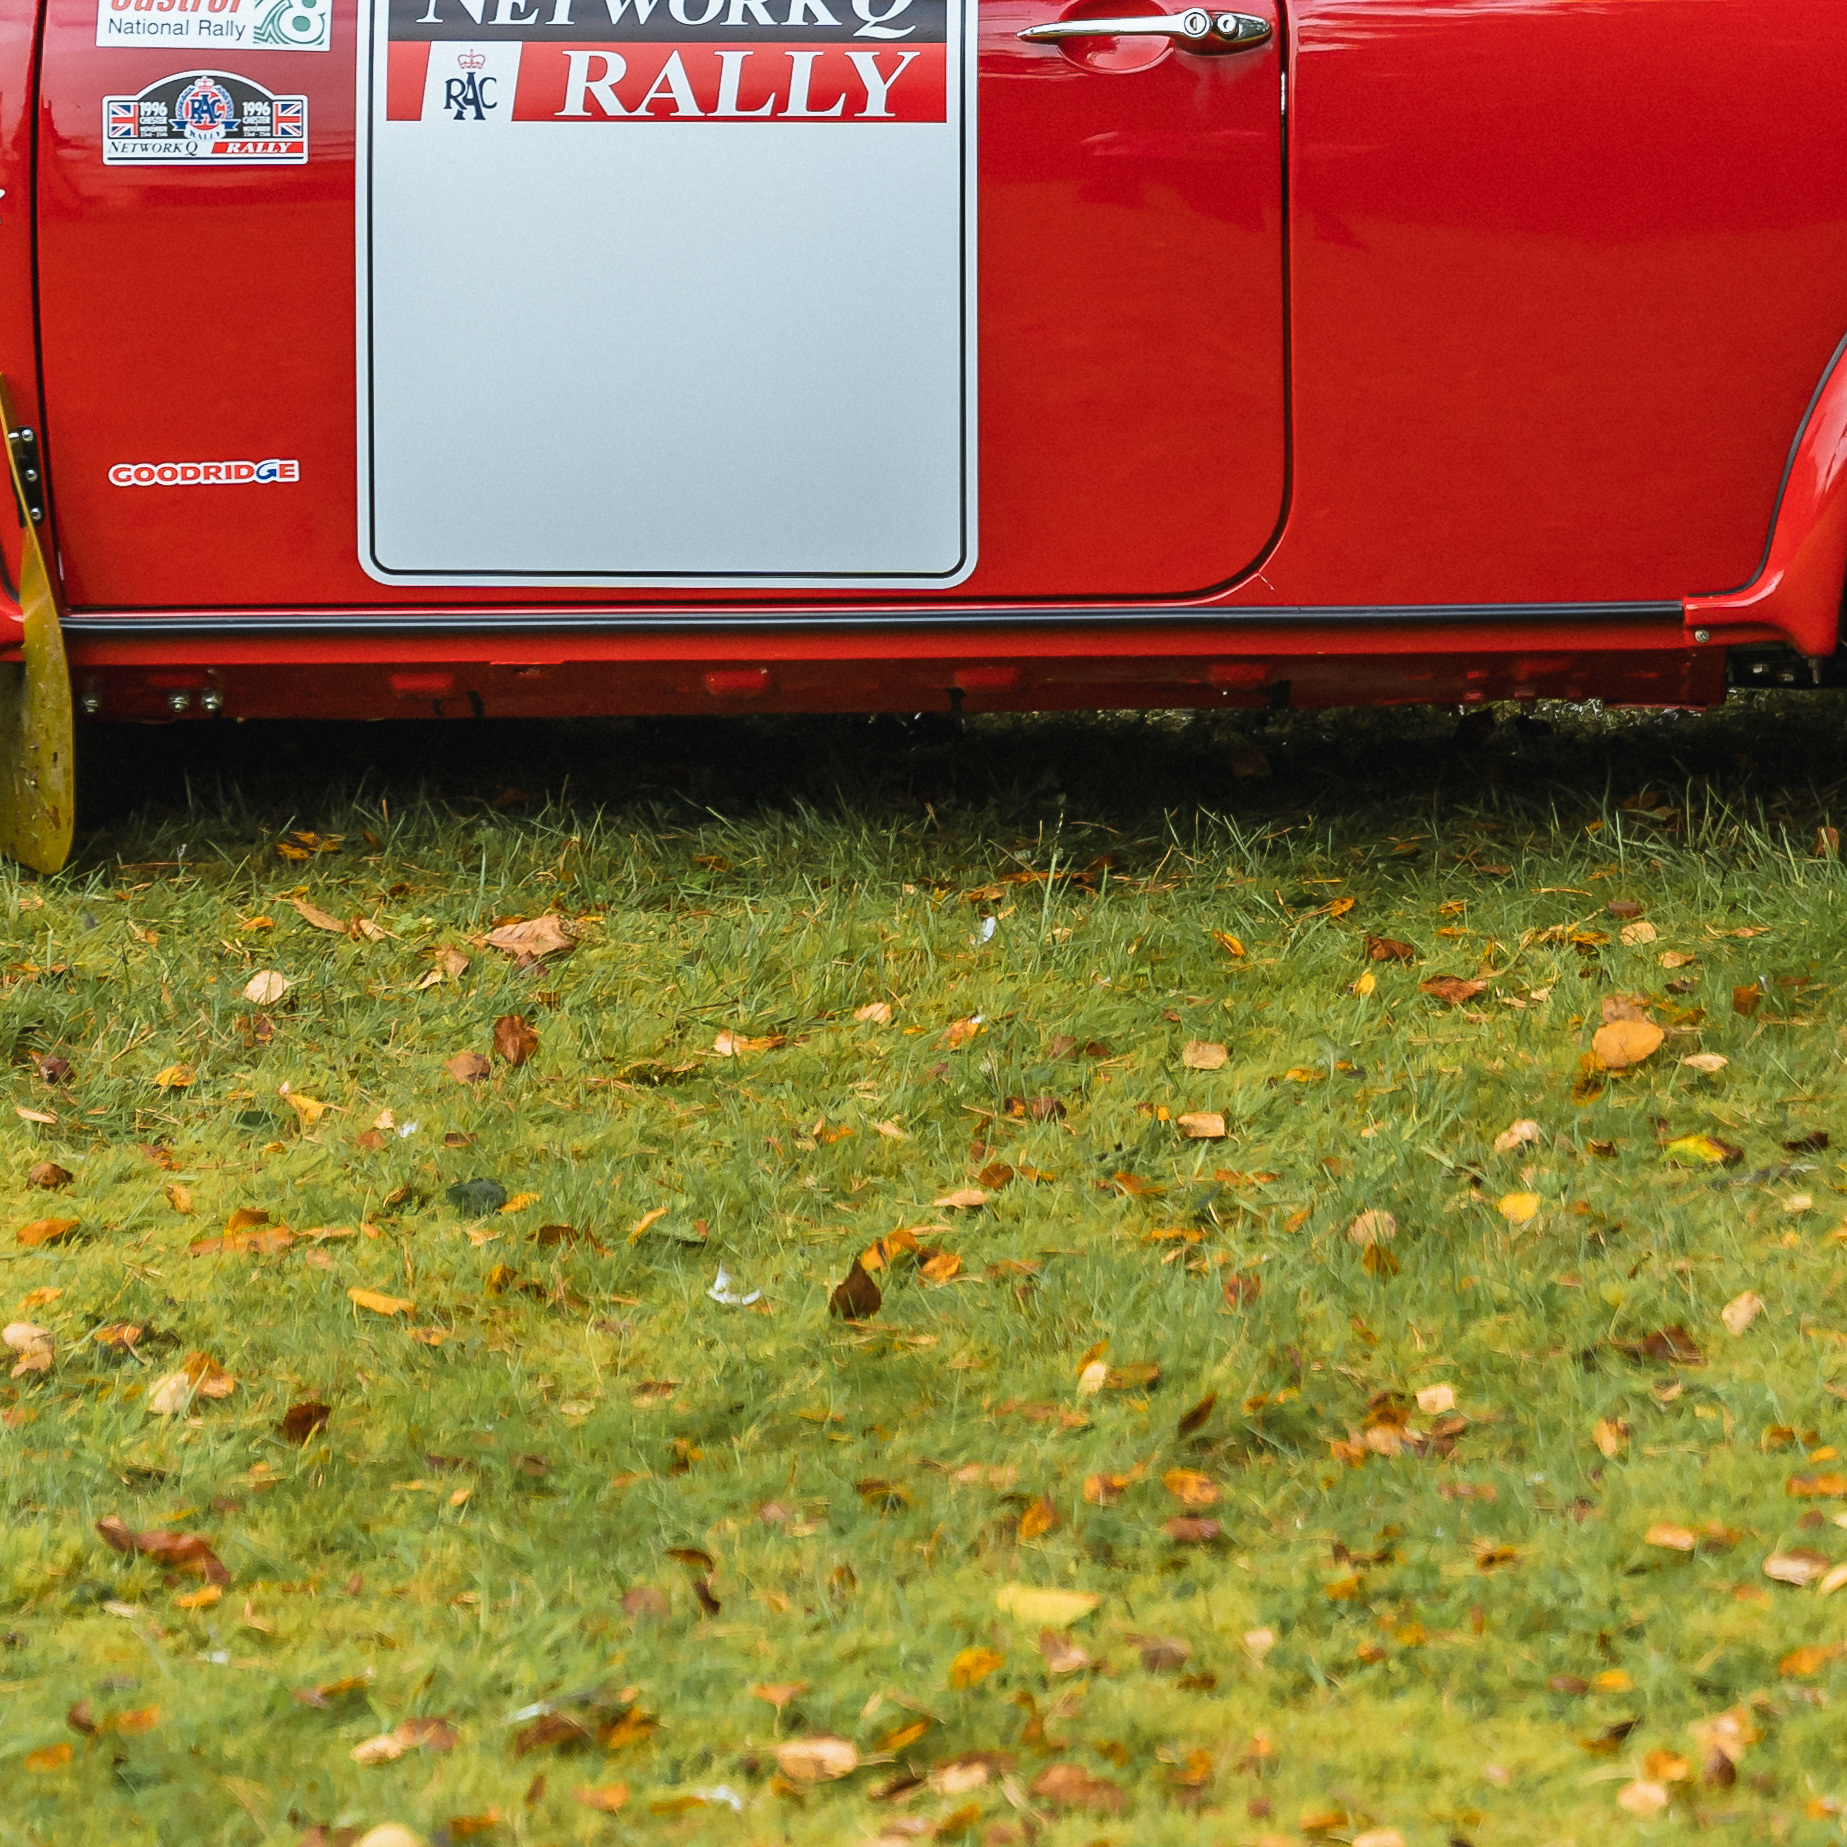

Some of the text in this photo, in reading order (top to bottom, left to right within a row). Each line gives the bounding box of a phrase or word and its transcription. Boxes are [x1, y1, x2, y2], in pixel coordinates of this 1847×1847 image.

[107, 18, 247, 41] National Rally
[553, 49, 922, 119] RALLY
[443, 72, 498, 121] RAC
[139, 101, 168, 116] 1996
[189, 94, 223, 125] RAC
[241, 101, 271, 116] 1996
[226, 141, 292, 154] RALLY
[112, 461, 296, 482] GOODRIDGE
